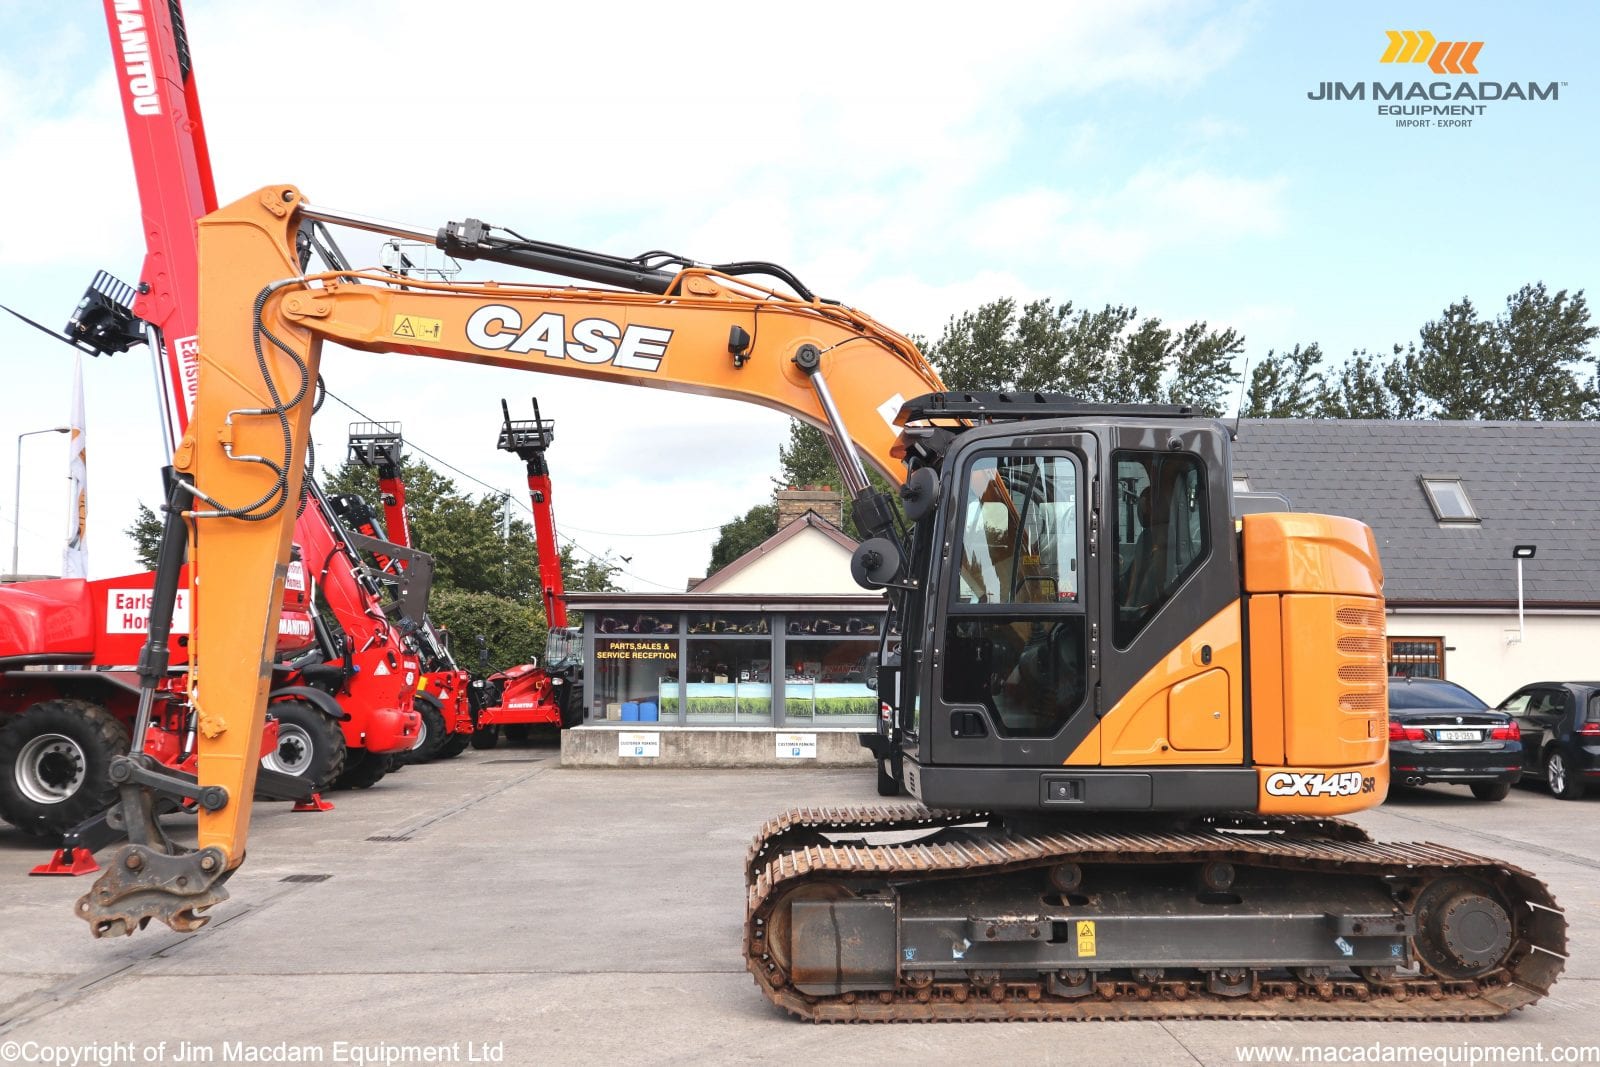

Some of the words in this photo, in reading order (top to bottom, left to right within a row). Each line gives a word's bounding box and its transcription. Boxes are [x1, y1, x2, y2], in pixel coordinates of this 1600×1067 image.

[465, 303, 674, 373] CASE
[115, 593, 183, 610] Earlst
[663, 642, 670, 650] &
[596, 651, 631, 659] SERVICE
[1265, 771, 1363, 797] CX145D
[1362, 776, 1376, 794] SR
